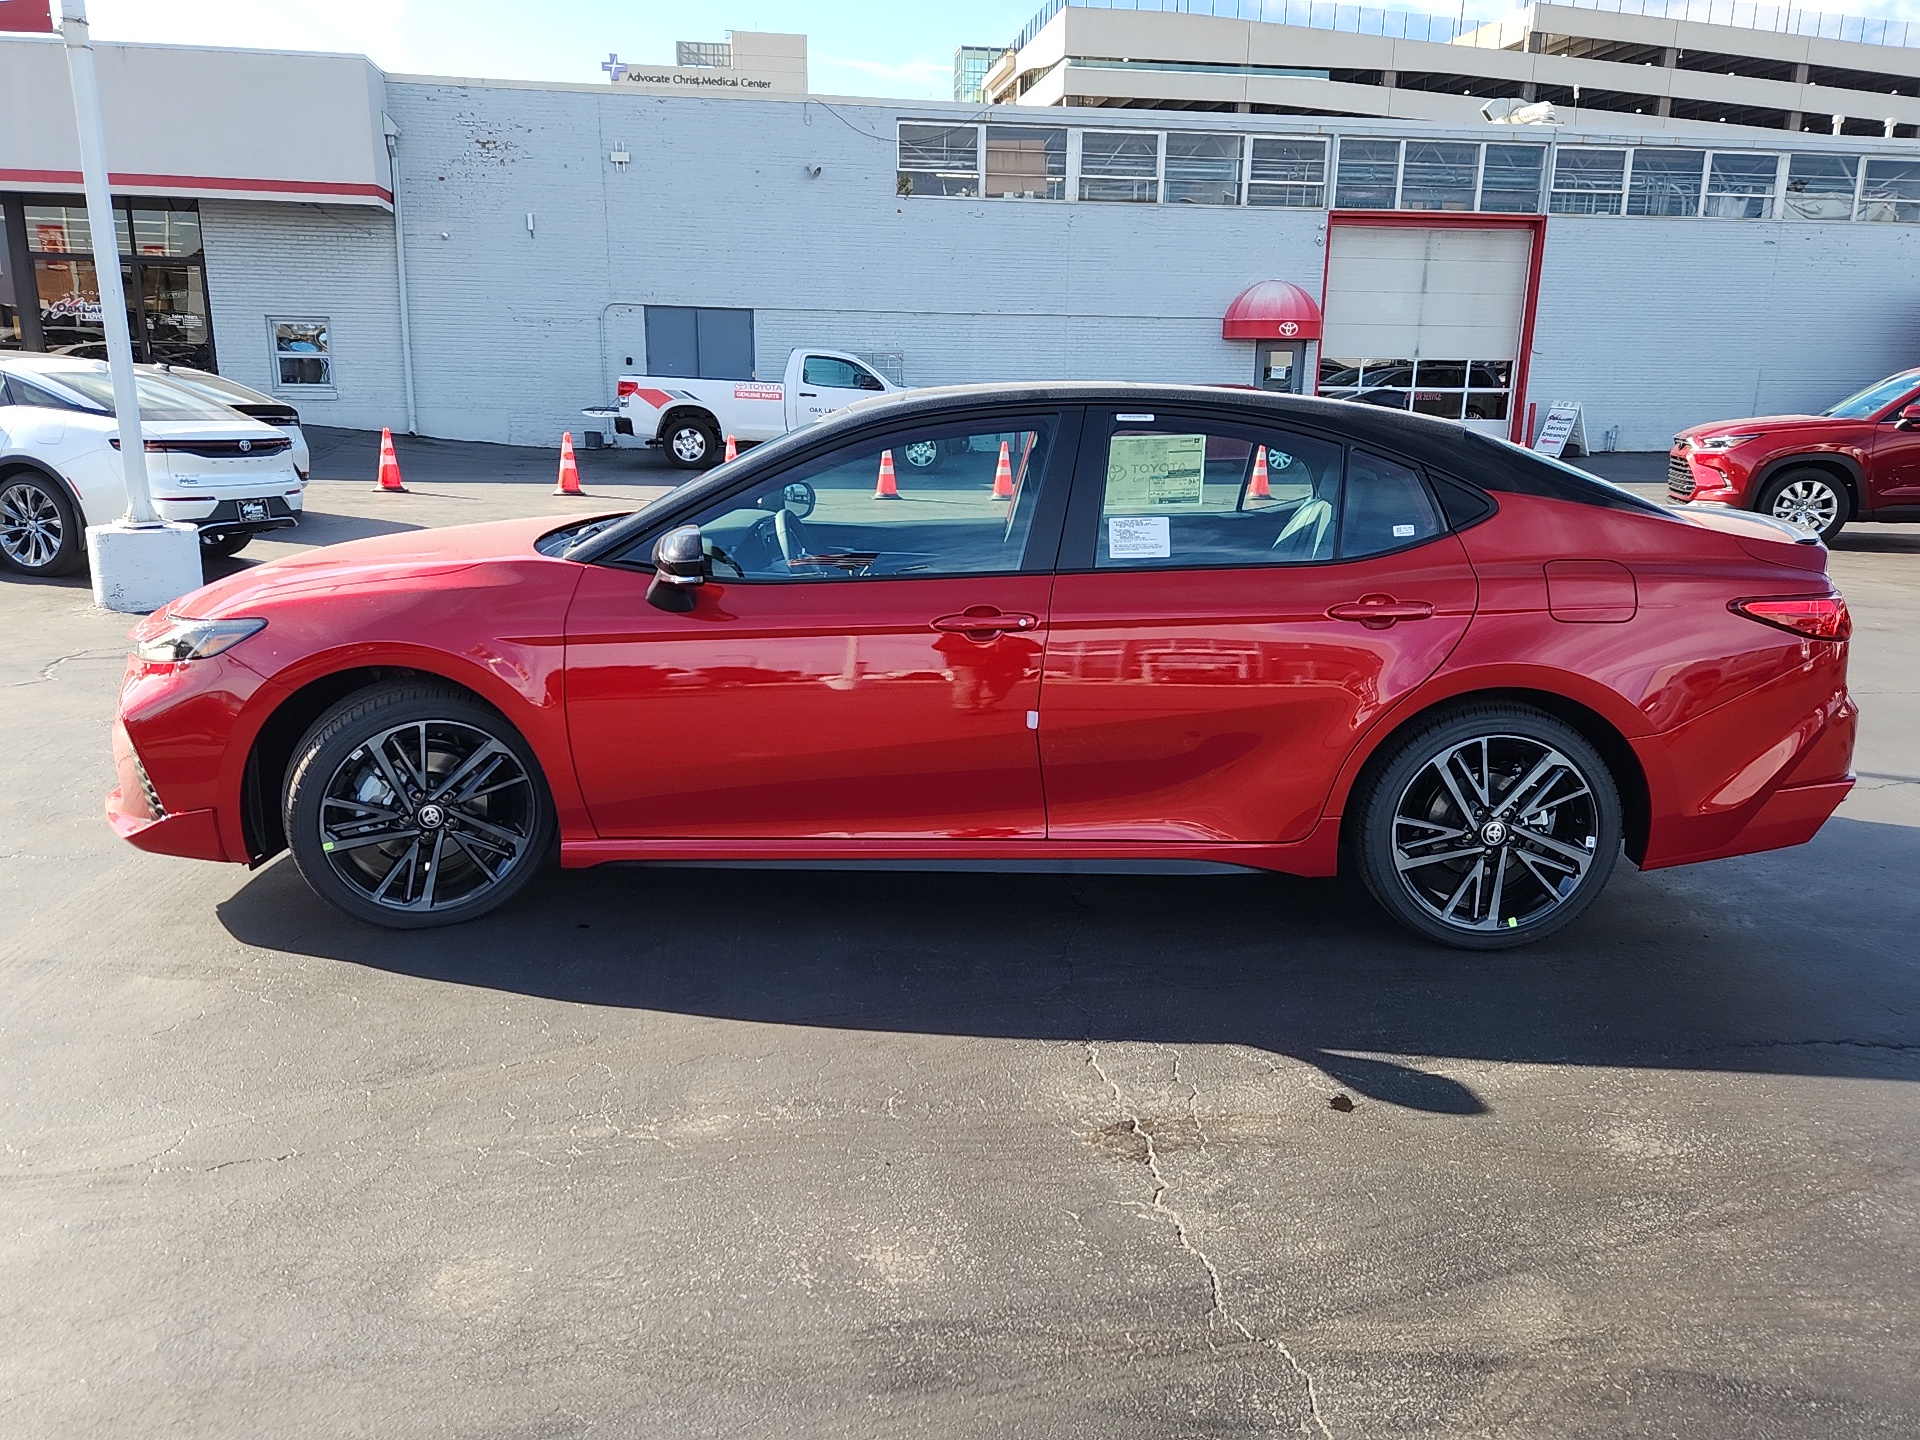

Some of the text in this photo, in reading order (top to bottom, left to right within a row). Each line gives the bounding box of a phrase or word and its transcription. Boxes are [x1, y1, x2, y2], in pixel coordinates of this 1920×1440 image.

[627, 73, 772, 89] Advocate Christ Medical Center
[61, 289, 100, 298] WELCO
[57, 302, 102, 314] OAKLA
[748, 383, 783, 391] TOYOTA
[1546, 424, 1568, 432] Service
[1541, 431, 1567, 439] Entrance
[1131, 462, 1186, 474] TOYOTA
